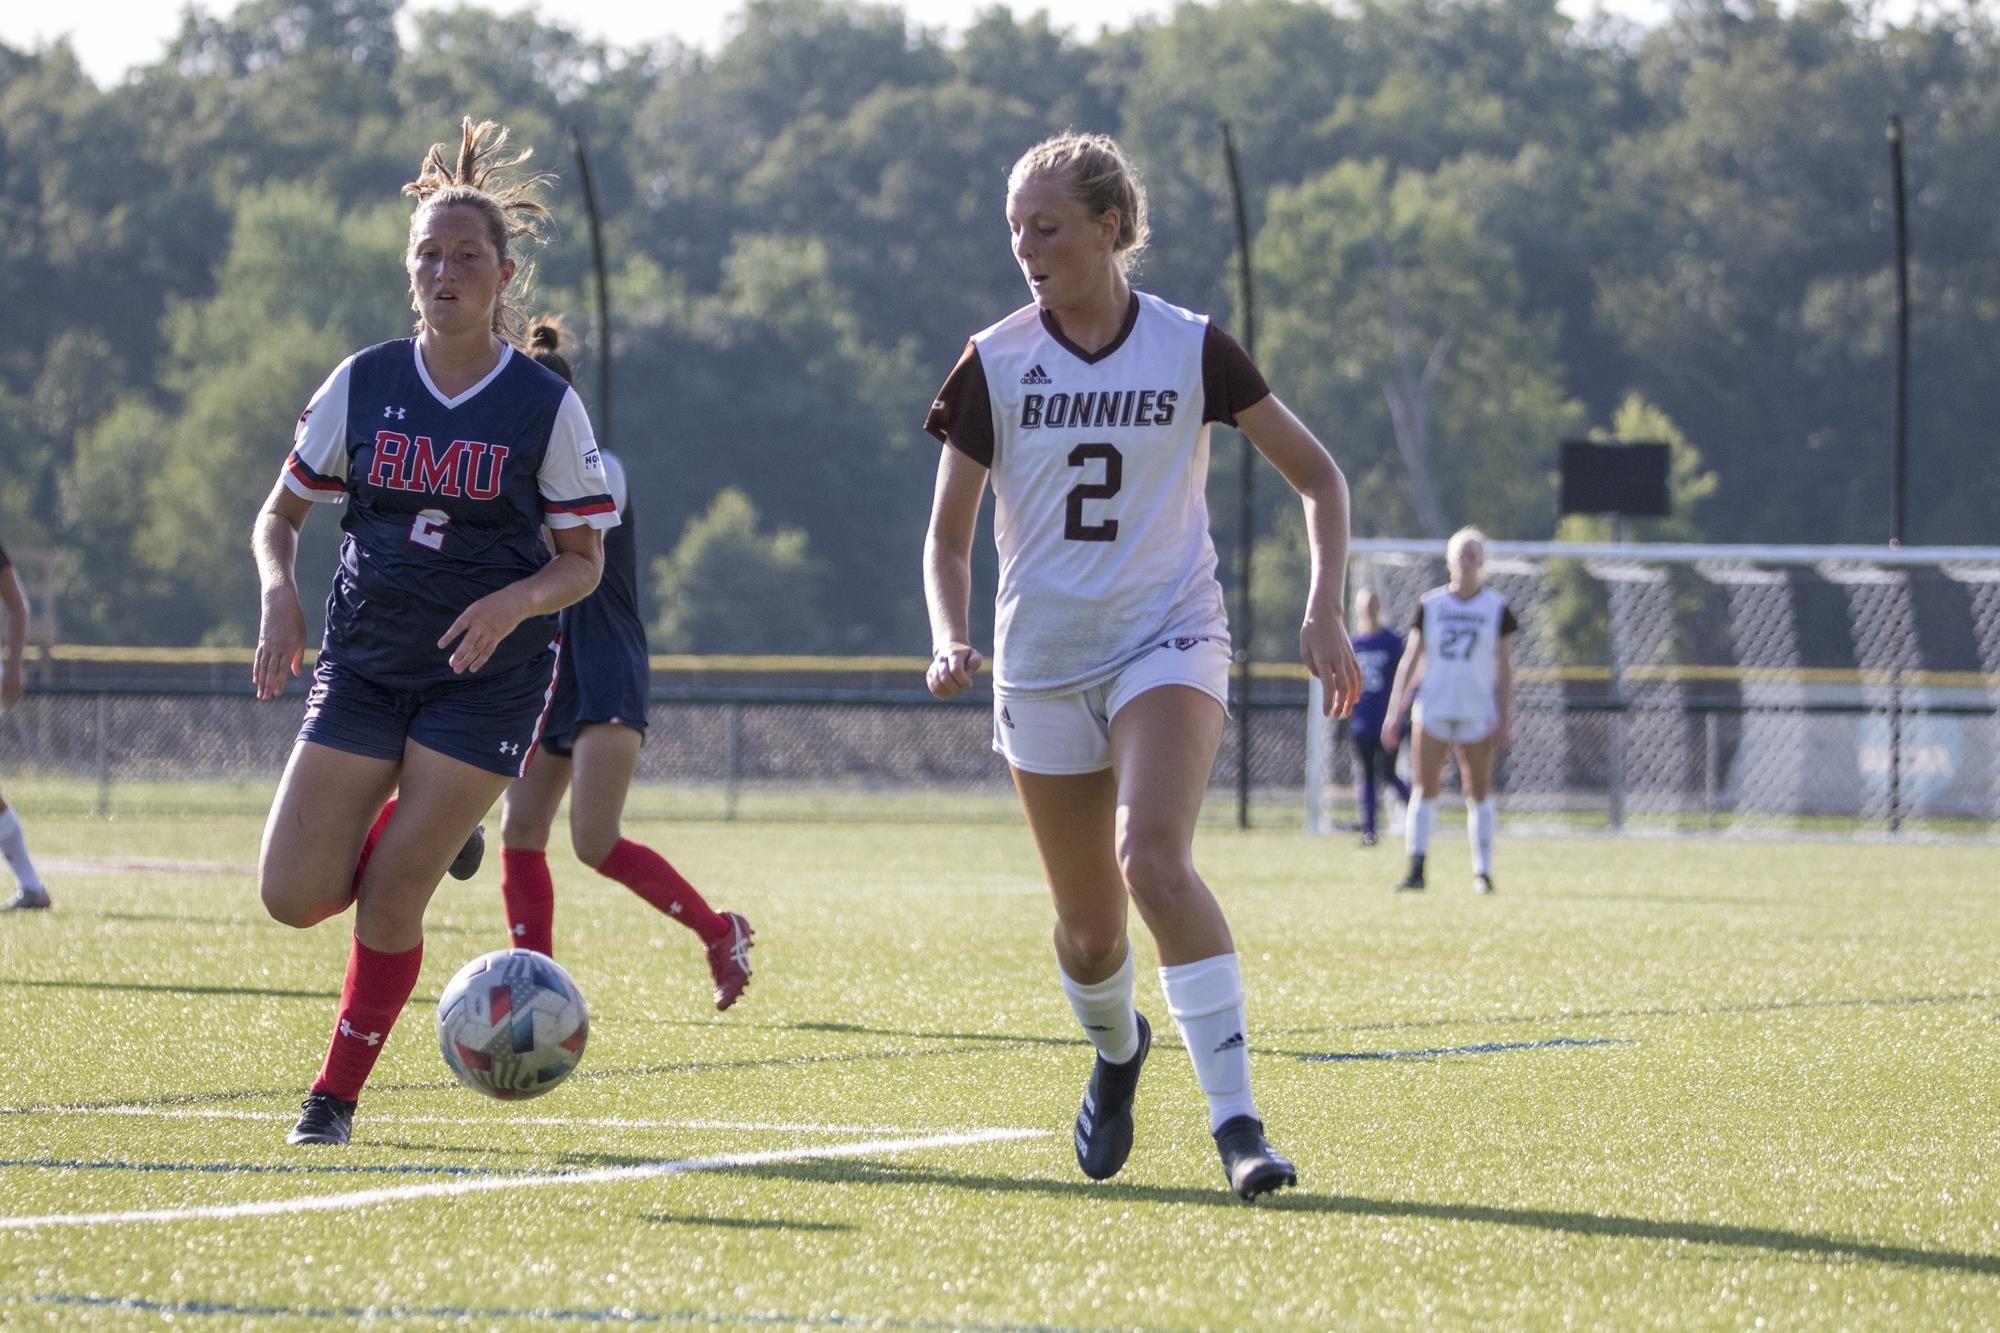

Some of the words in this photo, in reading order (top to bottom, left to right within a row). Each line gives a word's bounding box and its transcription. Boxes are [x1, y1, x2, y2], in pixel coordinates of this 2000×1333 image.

[1020, 390, 1178, 429] BONNIES
[368, 430, 509, 500] RMU
[1064, 443, 1123, 541] 2
[409, 508, 450, 551] 2
[1440, 629, 1478, 661] 27
